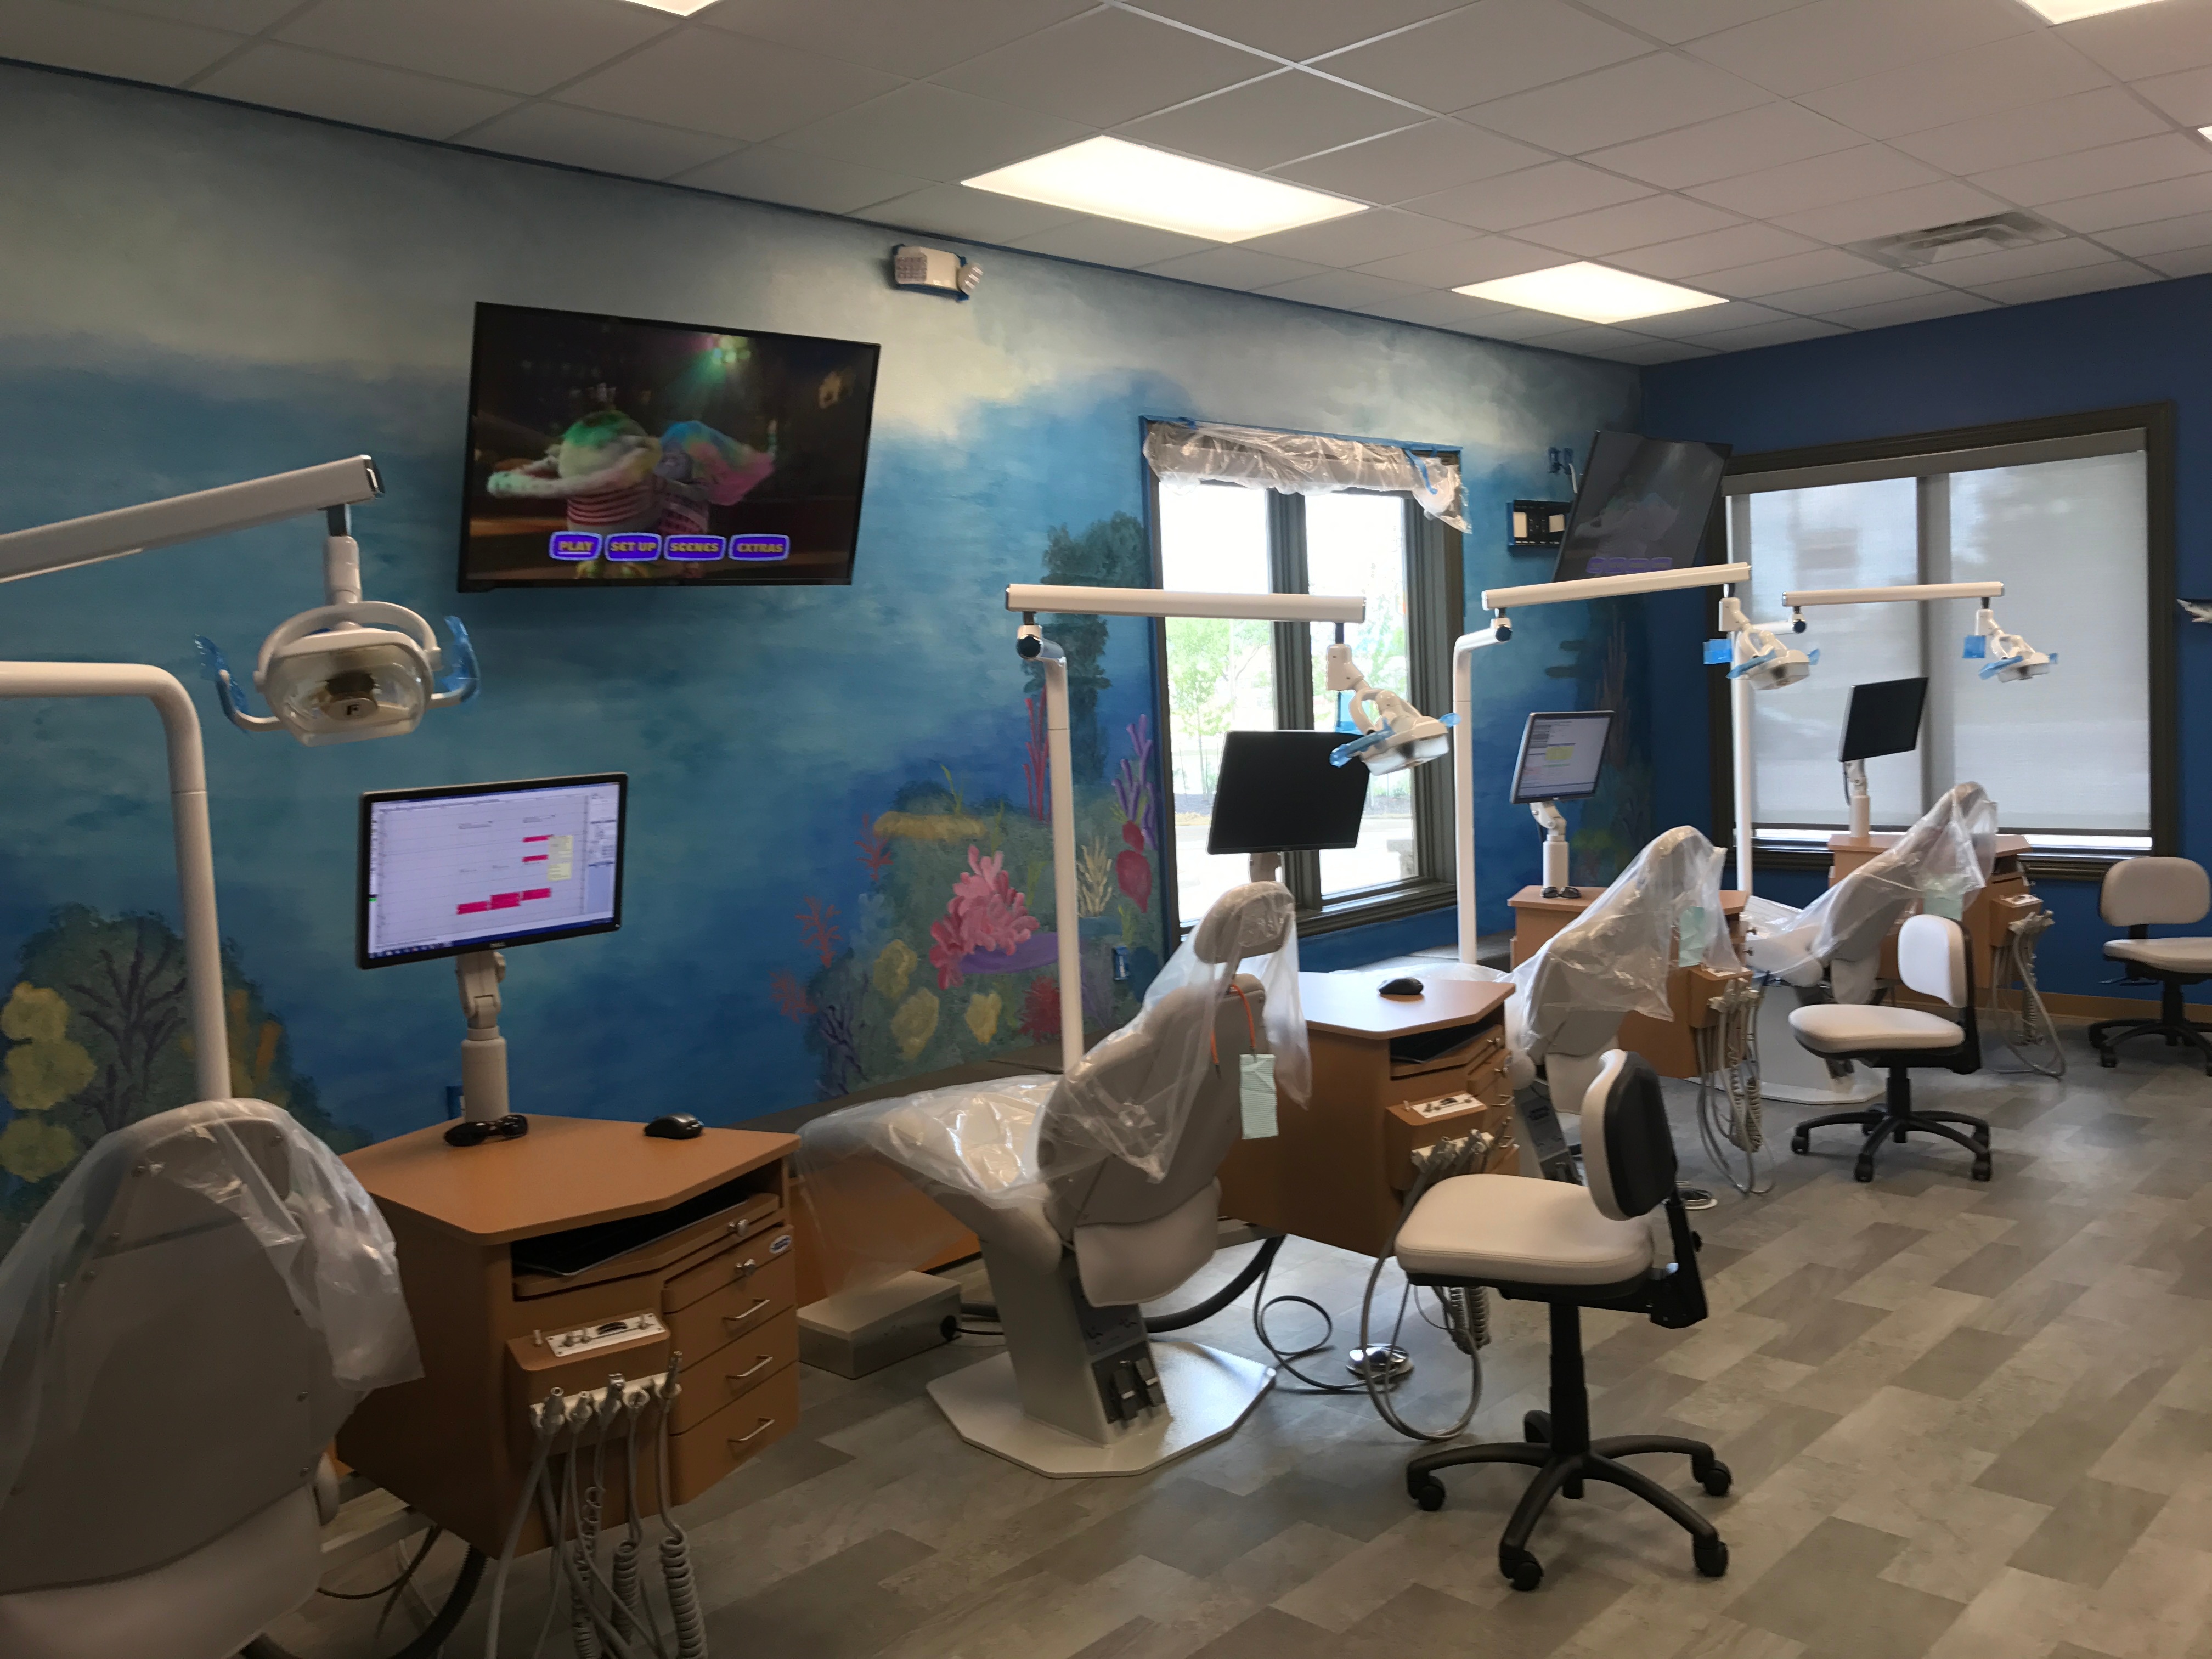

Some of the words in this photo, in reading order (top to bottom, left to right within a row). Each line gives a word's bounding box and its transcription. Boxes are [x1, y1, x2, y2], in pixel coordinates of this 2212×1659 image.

[559, 541, 594, 551] PLAY
[610, 541, 636, 552] SET
[637, 541, 657, 552] UP
[669, 542, 719, 552] SCENES
[737, 543, 783, 553] EXTRAS
